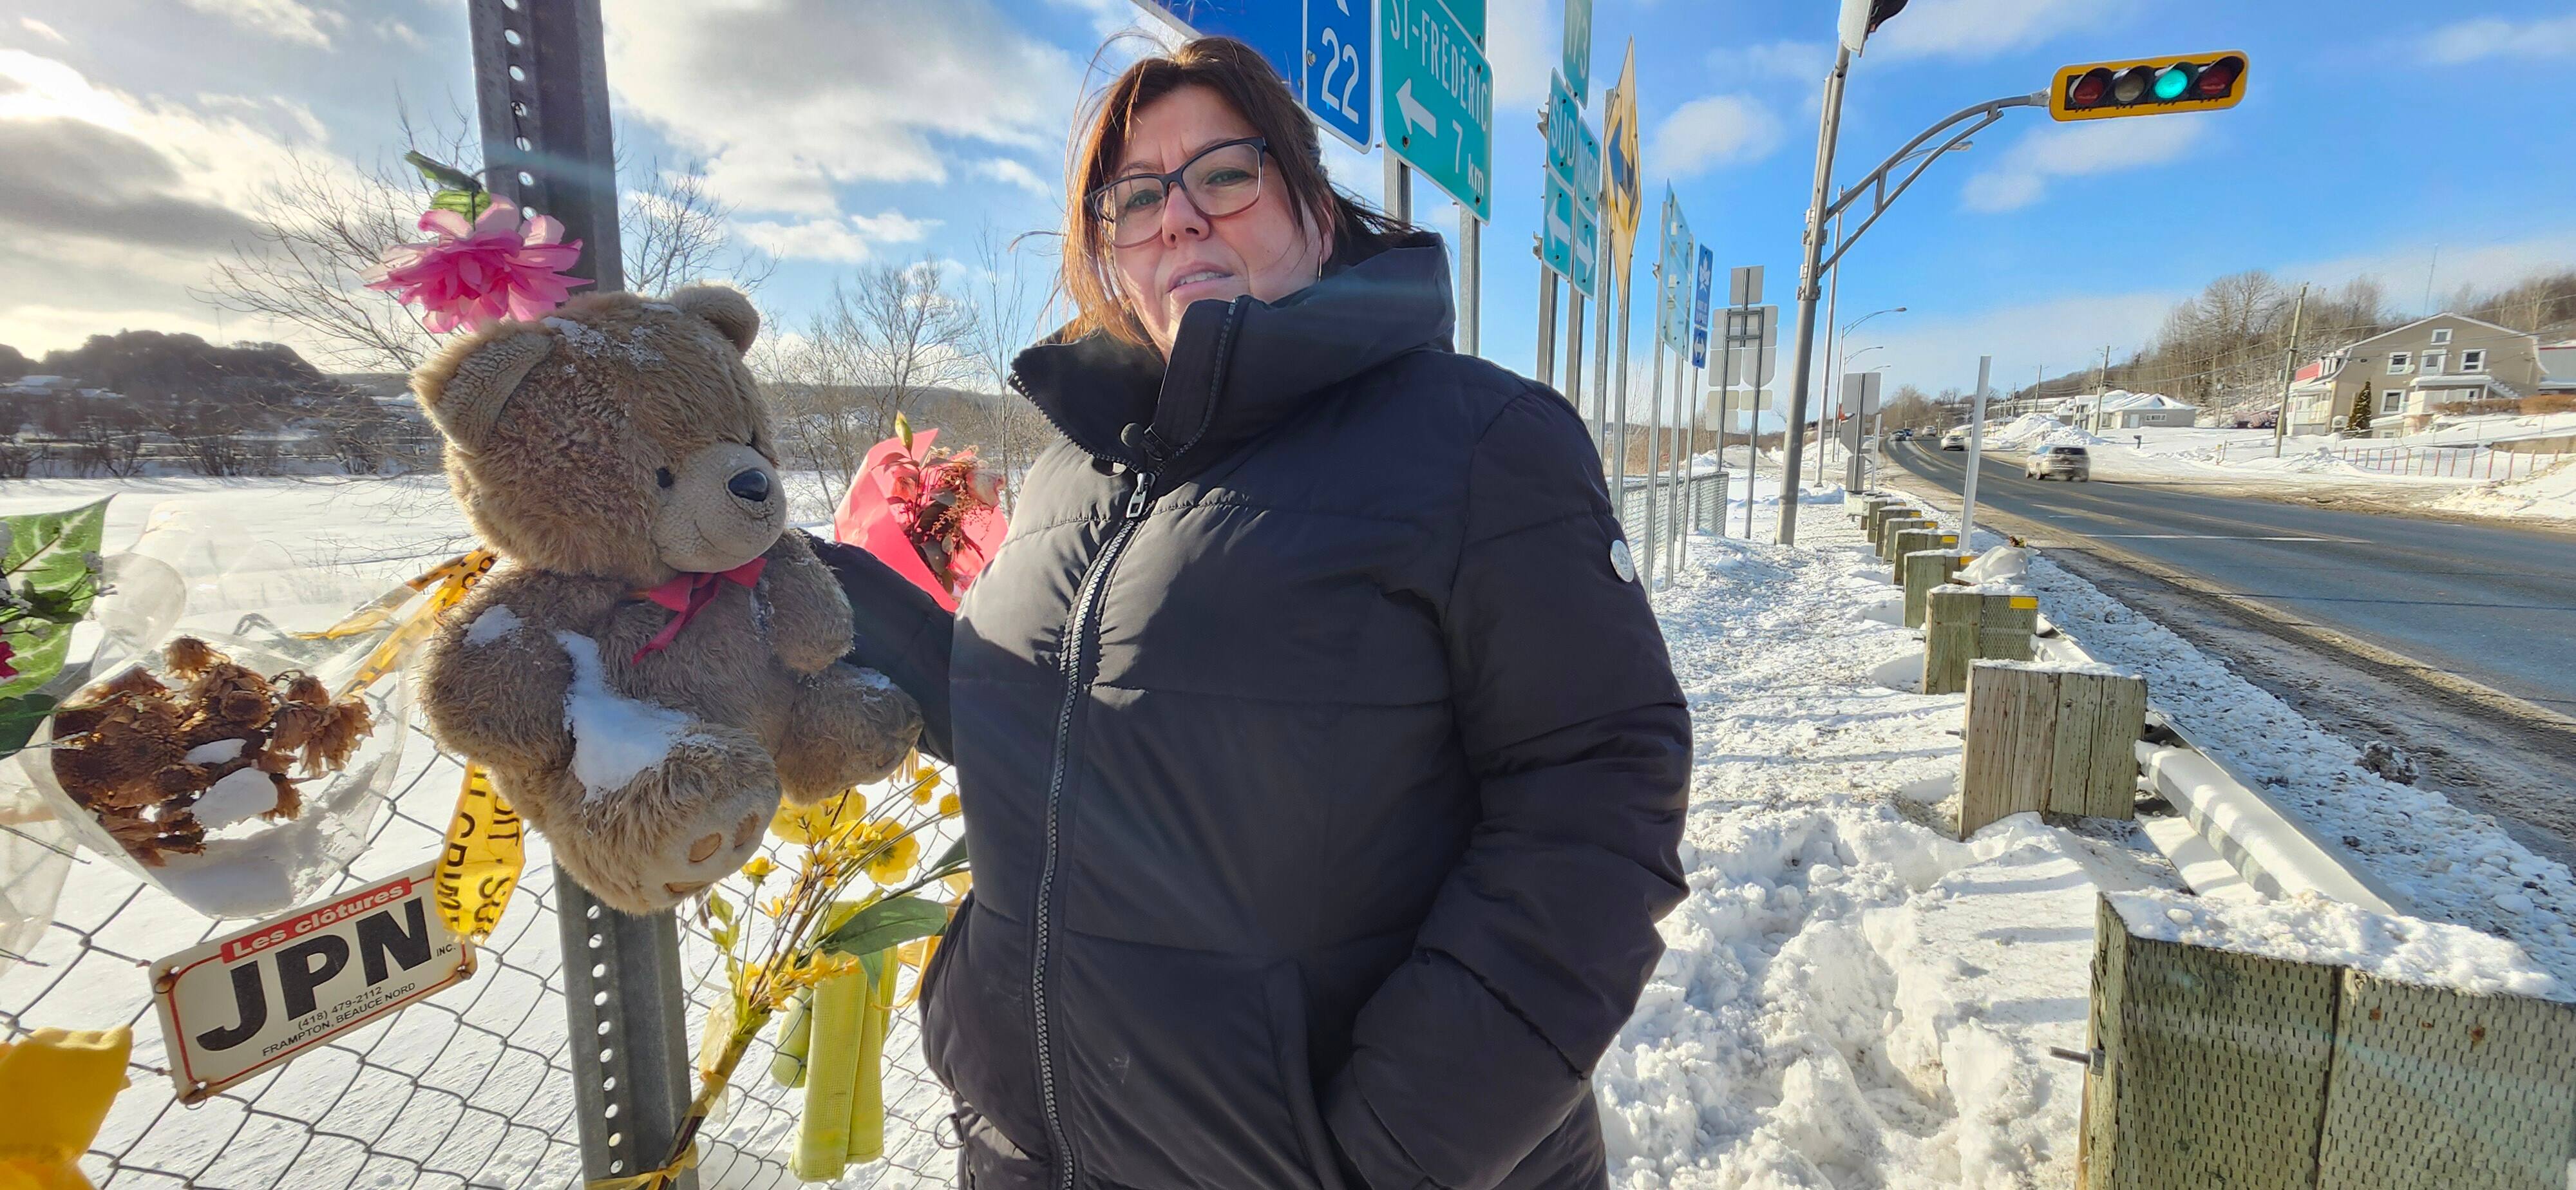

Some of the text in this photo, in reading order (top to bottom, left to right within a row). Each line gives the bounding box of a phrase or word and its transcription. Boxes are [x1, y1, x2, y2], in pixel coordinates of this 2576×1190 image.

[1321, 27, 1359, 124] 22
[1452, 118, 1484, 196] 7 km
[1551, 95, 1576, 167] SUD
[1578, 137, 1598, 202] NORD
[232, 884, 404, 958] Les clôtures
[436, 943, 456, 957] INC.
[196, 896, 432, 1051] JPN
[298, 987, 383, 1030] (418) 479-2112
[262, 982, 415, 1057] FRAMPTON, BEAUCE NORD
